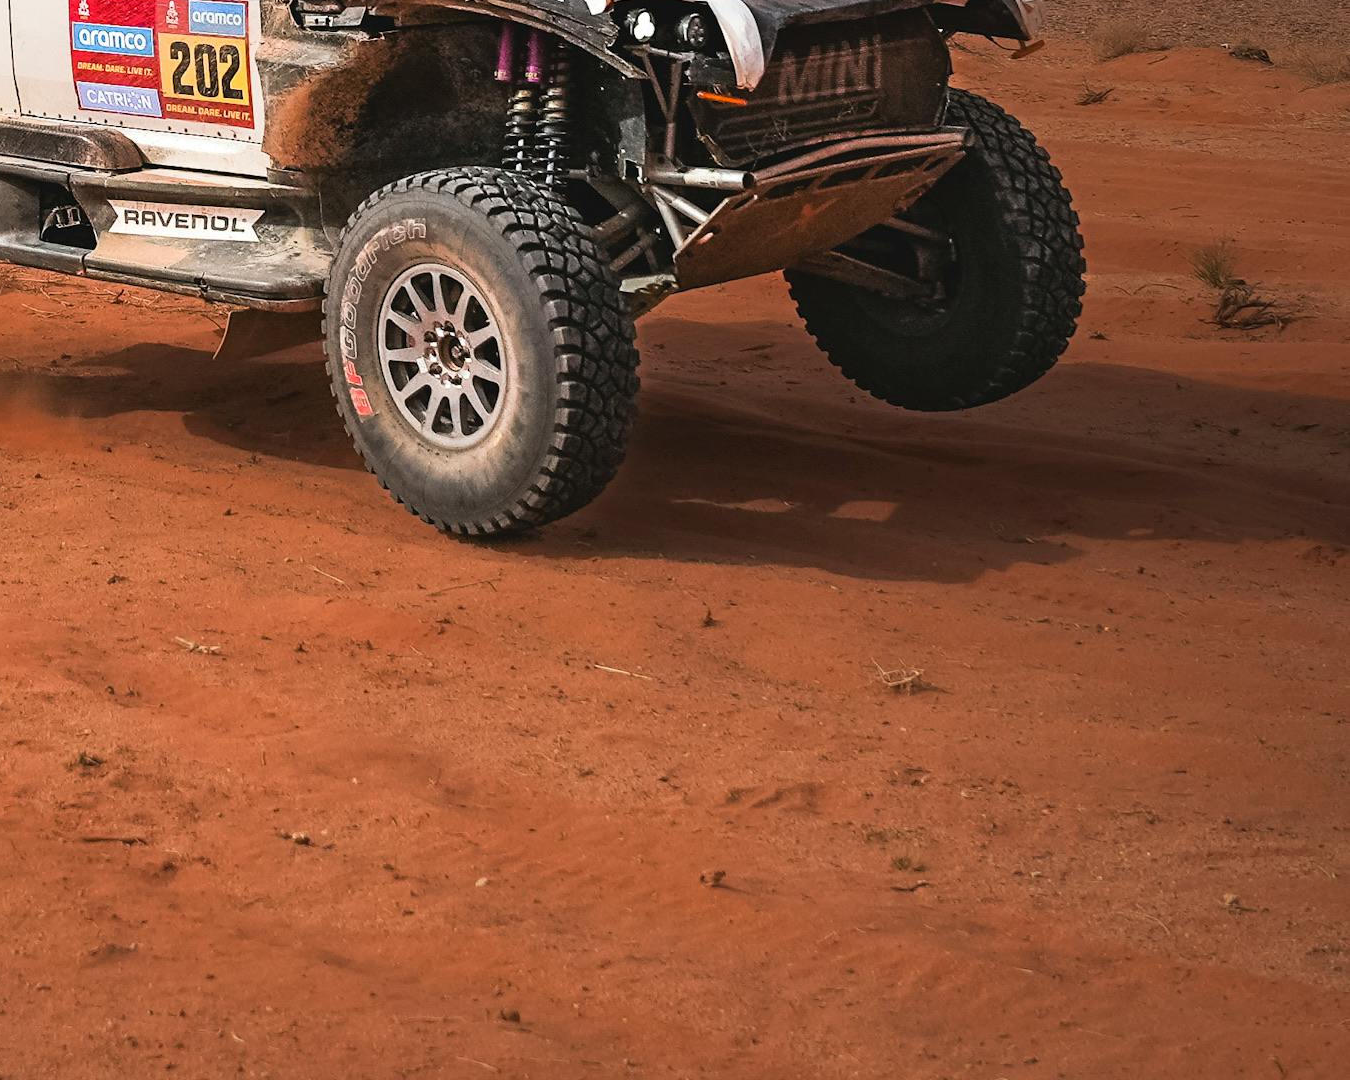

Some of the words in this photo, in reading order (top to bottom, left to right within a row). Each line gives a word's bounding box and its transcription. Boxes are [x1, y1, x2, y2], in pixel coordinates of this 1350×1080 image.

[192, 11, 242, 26] aramco
[79, 28, 146, 50] aramco
[77, 62, 104, 71] DREAM.
[105, 64, 125, 74] DARE.
[126, 66, 144, 75] LIVE
[170, 41, 244, 100] 202
[778, 34, 882, 105] MINI
[166, 104, 198, 114] DREAM.
[199, 107, 222, 117] DARE.
[223, 110, 240, 120] LIVE
[124, 209, 246, 233] RAVENOL
